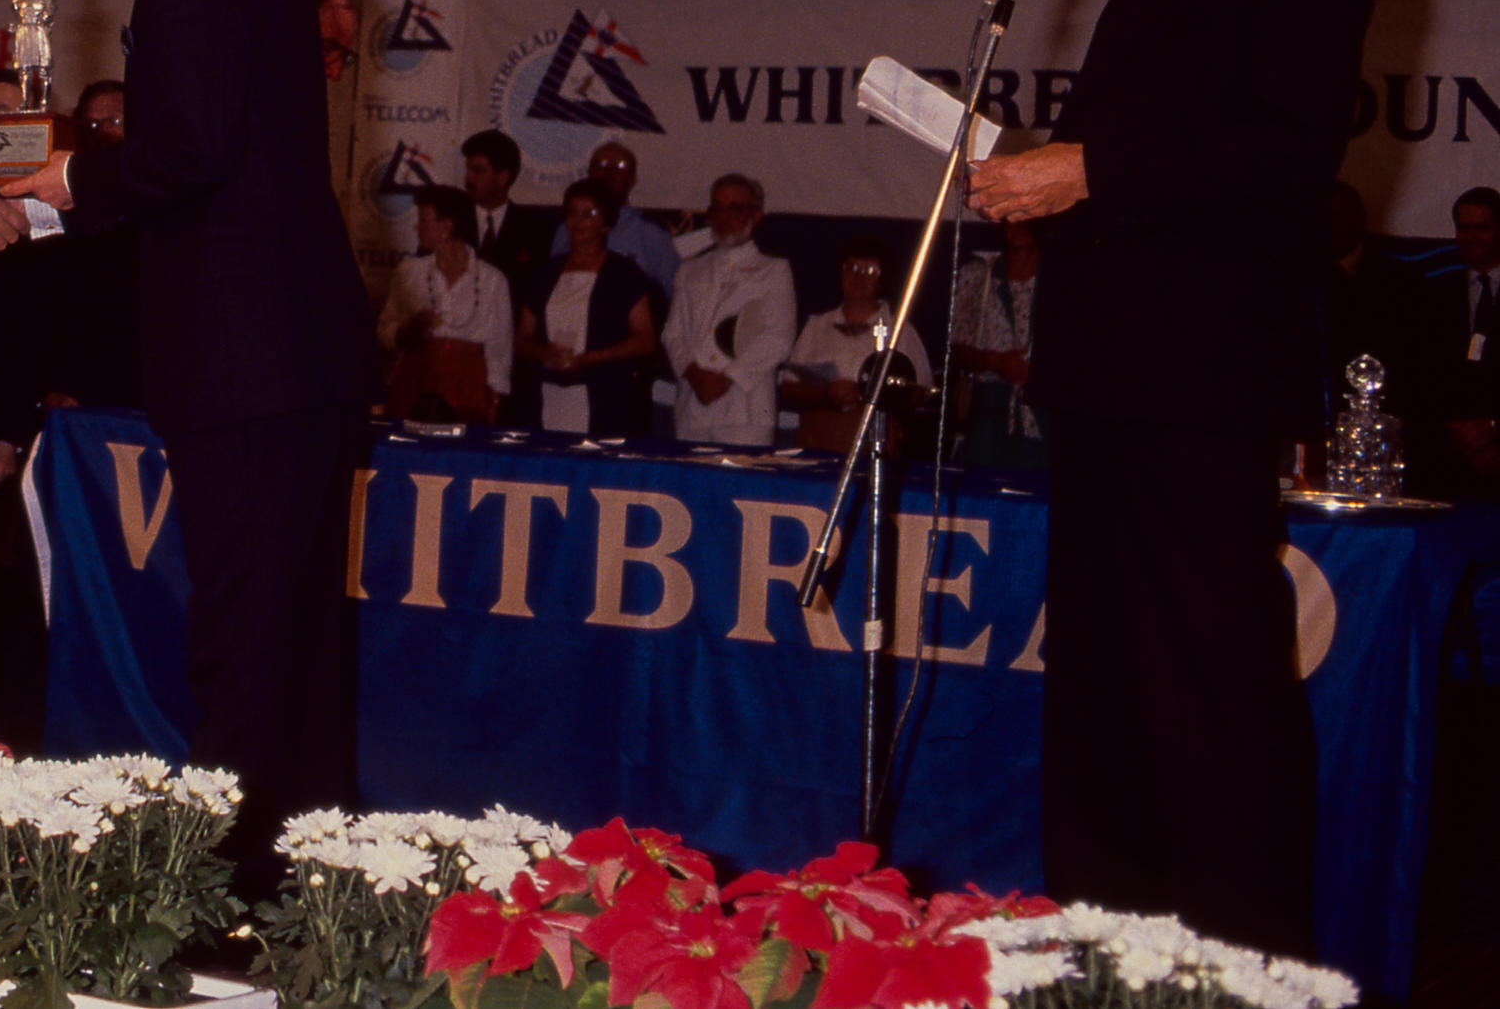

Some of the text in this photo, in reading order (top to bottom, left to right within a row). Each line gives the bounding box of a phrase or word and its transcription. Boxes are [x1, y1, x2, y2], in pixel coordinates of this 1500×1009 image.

[363, 103, 451, 122] TELECOM
[685, 65, 1081, 130] WHIRE
[106, 441, 1337, 681] WITBRE
